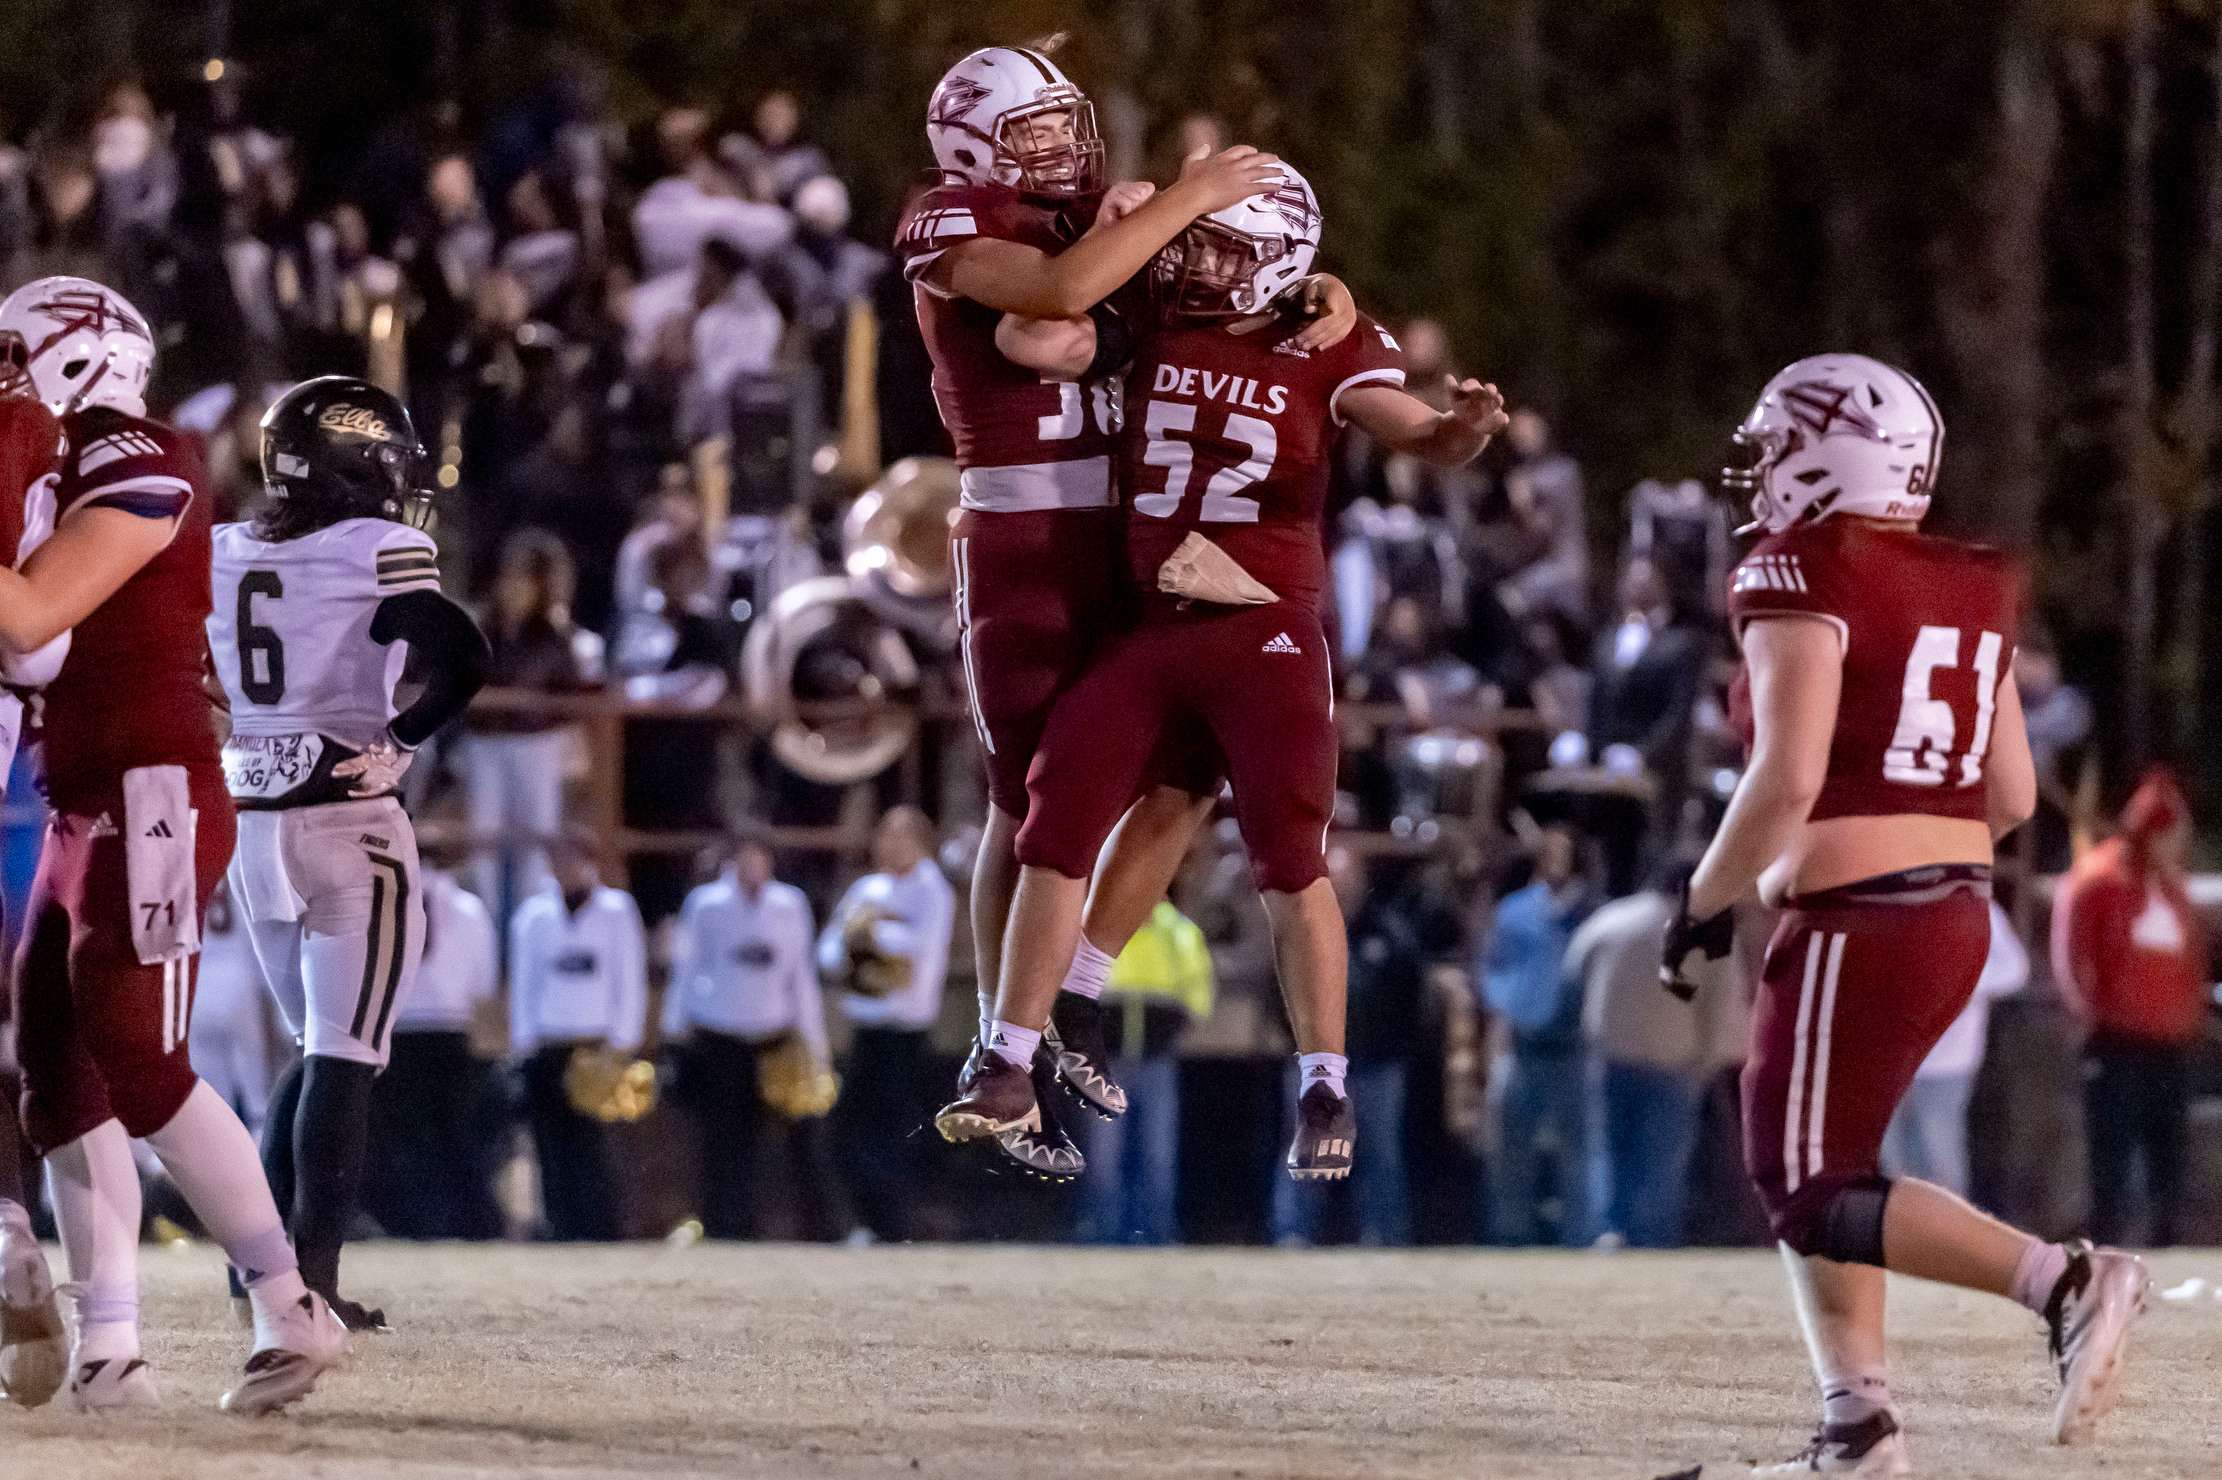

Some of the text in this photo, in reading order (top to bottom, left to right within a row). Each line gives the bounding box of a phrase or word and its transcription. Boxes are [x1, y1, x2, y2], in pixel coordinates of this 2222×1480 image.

[1272, 345, 1310, 358] adidas
[1153, 364, 1288, 414] DEVILS
[319, 402, 391, 440] Elba
[1134, 399, 1278, 522] 52
[236, 570, 285, 706] 6
[1262, 644, 1301, 654] adidas
[1883, 625, 2003, 788] 61
[141, 900, 174, 931] 71
